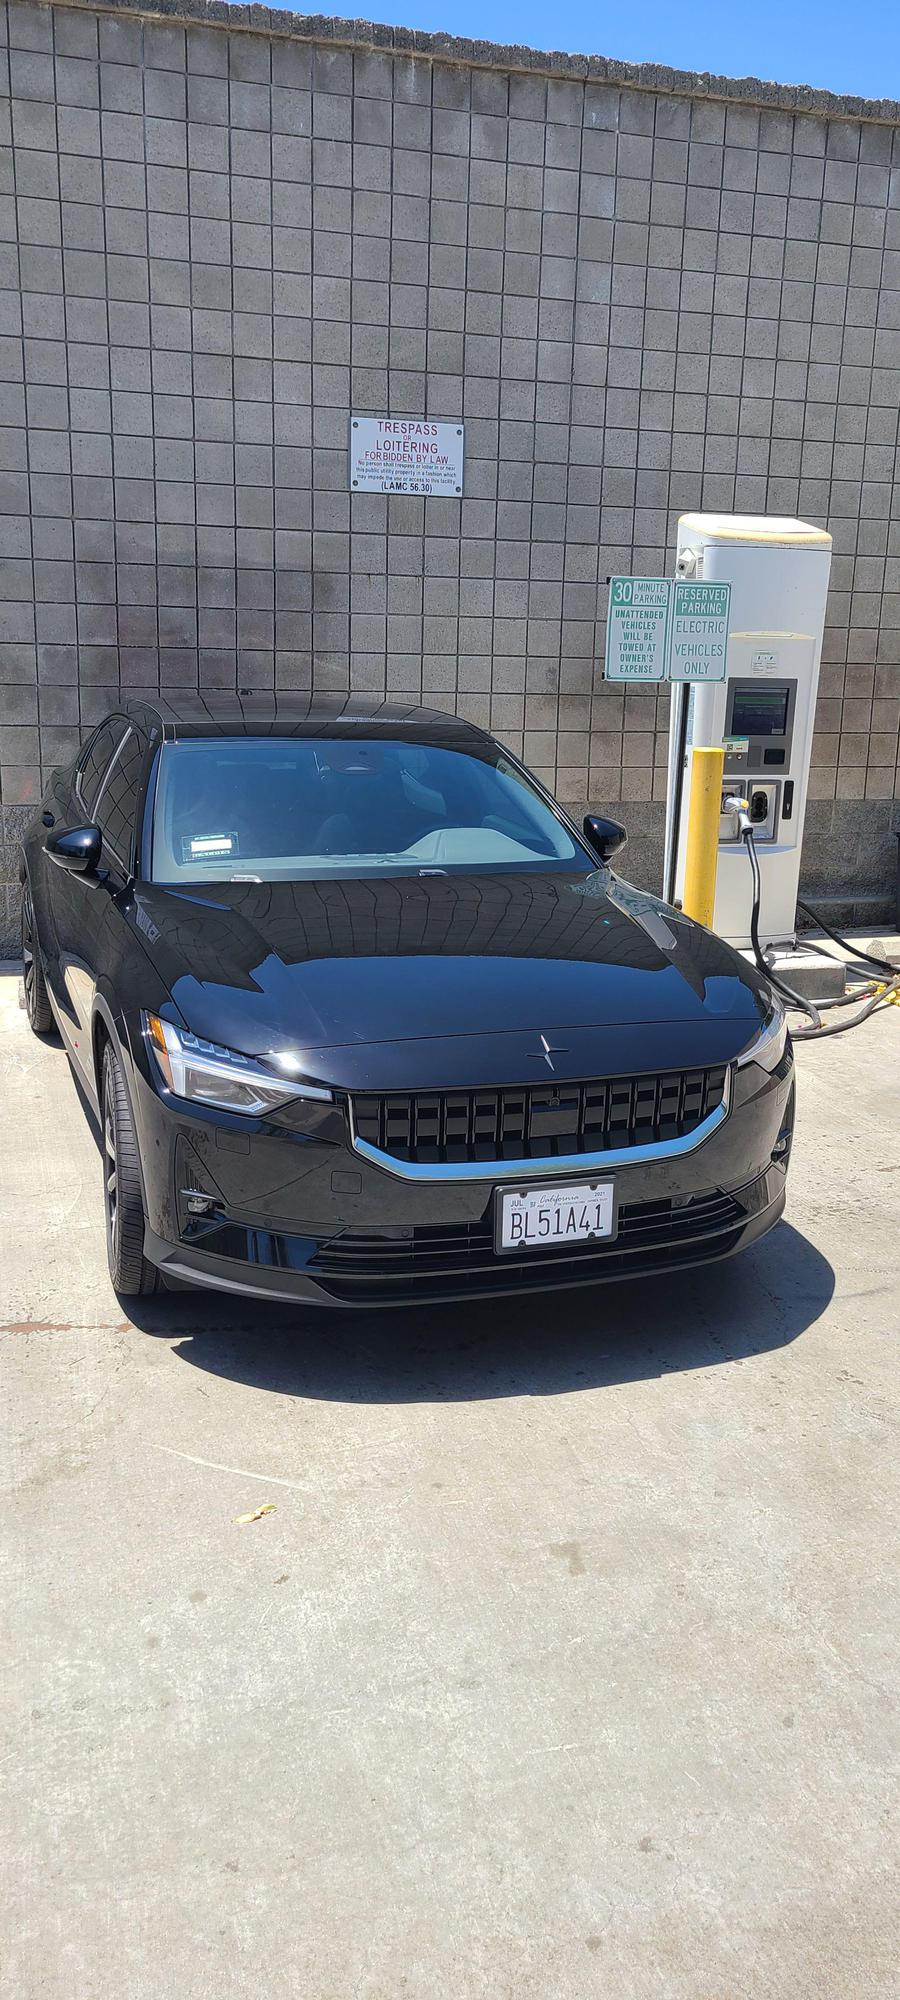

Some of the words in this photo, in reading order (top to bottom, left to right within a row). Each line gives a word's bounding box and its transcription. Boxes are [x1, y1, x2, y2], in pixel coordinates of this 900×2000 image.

[378, 422, 438, 435] TRESPASS
[376, 440, 438, 454] LOITERING
[365, 451, 413, 462] FORBIDDEN
[417, 455, 427, 463] BY
[430, 456, 448, 464] LAW
[382, 482, 408, 491] (LAMC
[410, 483, 432, 493] 56.30)
[614, 582, 632, 602] 30
[637, 583, 665, 593] MINUTE
[678, 588, 726, 600] RESERVED
[634, 594, 667, 604] PARKING
[682, 602, 721, 614] PARKING
[616, 610, 663, 619] UNATTENDED
[622, 621, 656, 630] VEHICLES
[676, 621, 725, 633] ELECTRIC
[623, 632, 641, 640] WILL
[618, 643, 644, 651] TOWED
[647, 643, 656, 652] AT
[675, 644, 723, 656] VEHICLES
[620, 654, 654, 662] OWNER'S
[620, 664, 652, 673] EXPENSE
[684, 662, 710, 674] ONLY
[540, 1194, 579, 1206] California
[510, 1204, 604, 1240] BL51A41
